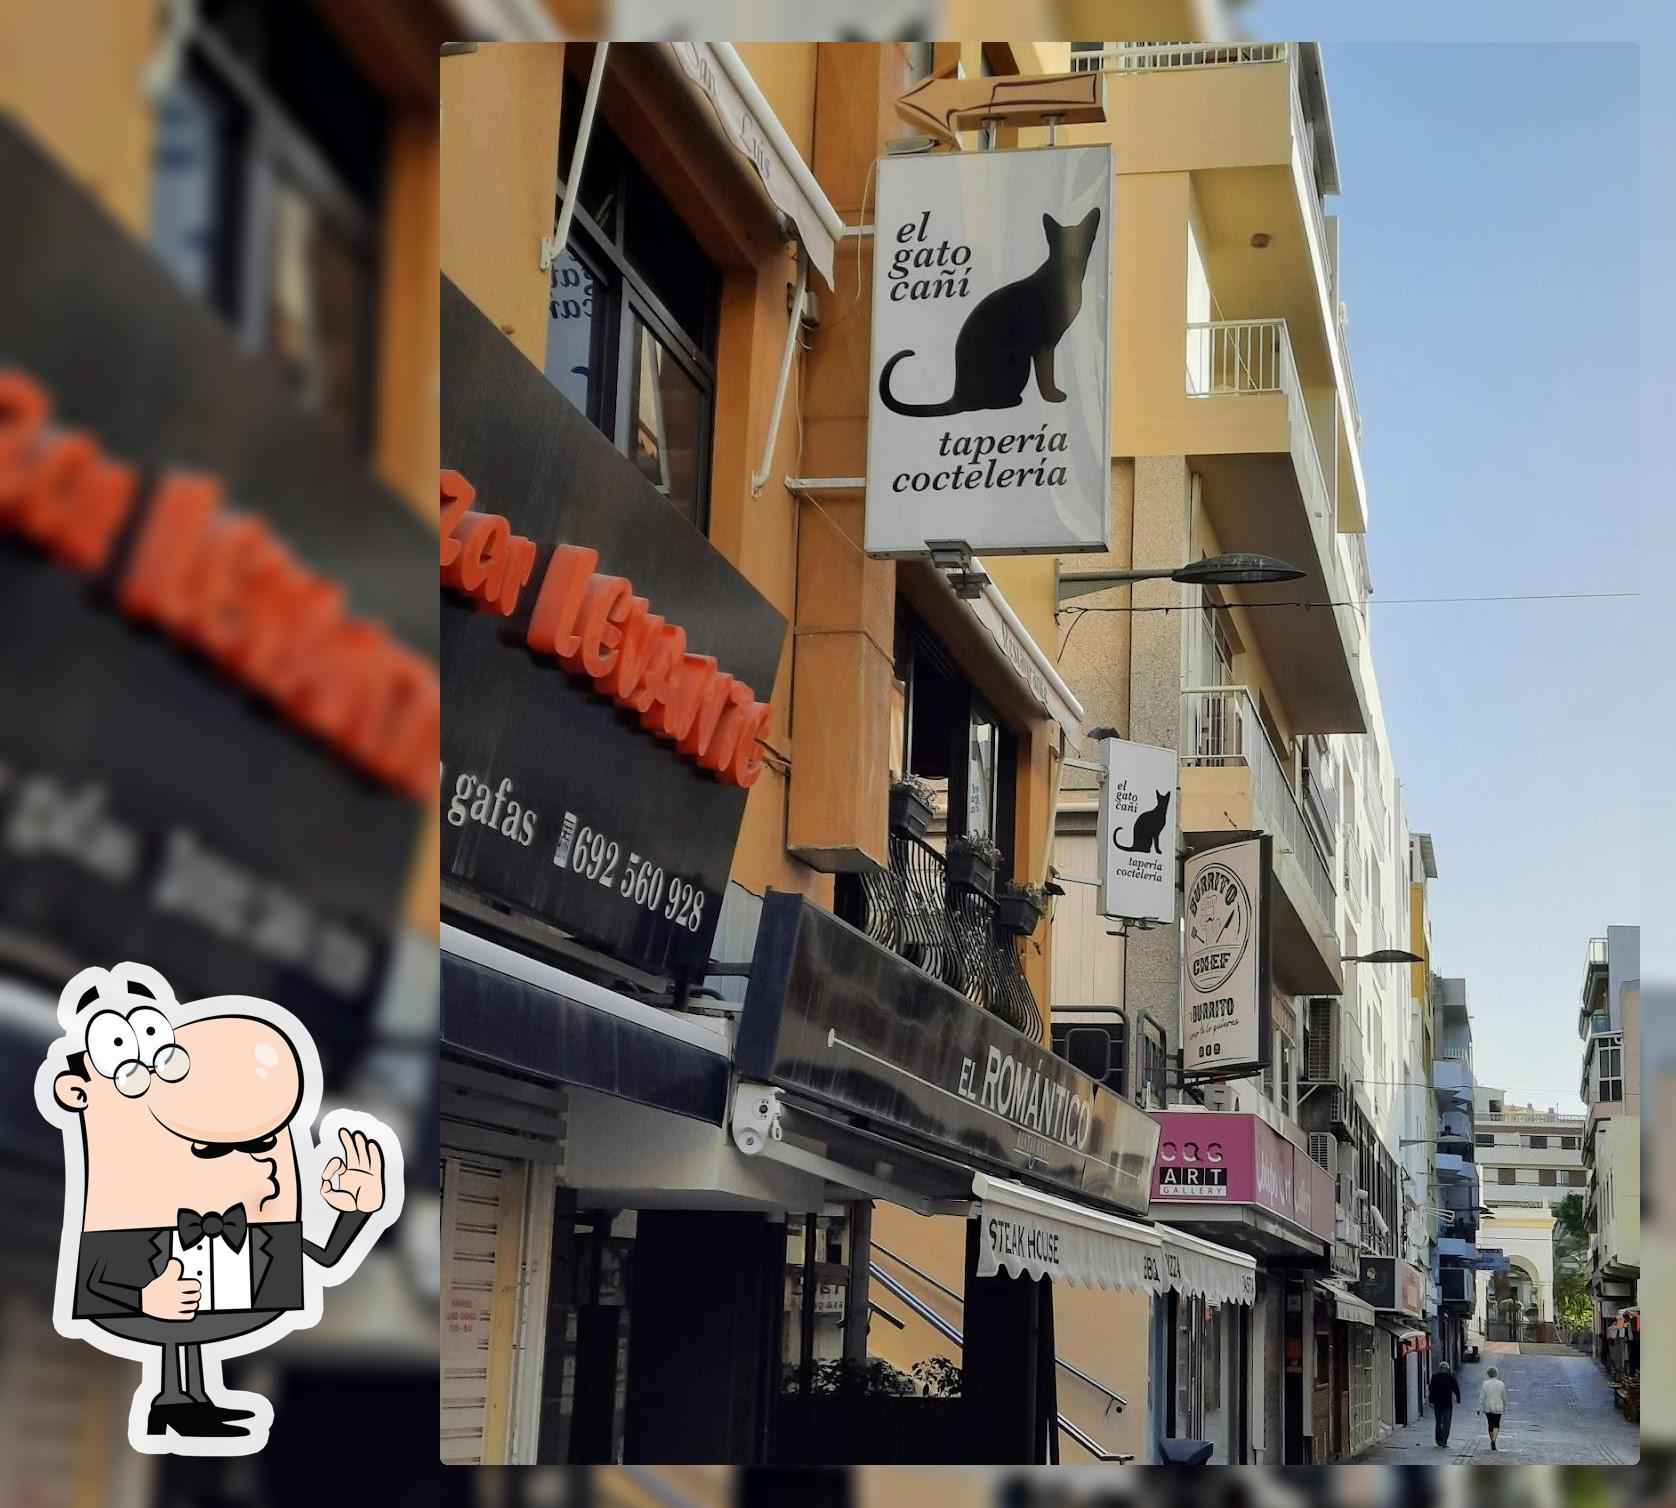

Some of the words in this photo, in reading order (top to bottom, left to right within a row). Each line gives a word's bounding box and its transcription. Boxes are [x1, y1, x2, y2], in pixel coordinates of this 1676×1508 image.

[895, 210, 931, 244] el
[888, 241, 972, 280] gato
[889, 267, 974, 302] cañí
[938, 424, 1068, 465] tapería
[892, 457, 1068, 493] coctelería
[1115, 791, 1138, 803] gato
[1117, 780, 1128, 791] el
[447, 773, 539, 847] gafas
[572, 826, 619, 888] 692
[620, 852, 664, 911] 560
[664, 877, 705, 933] 928
[1128, 857, 1163, 871] tapería
[1116, 868, 1163, 882] coctelería
[1189, 872, 1238, 918] BURRITO
[1193, 952, 1231, 976] CHEF
[1192, 997, 1235, 1023] BURRITO
[958, 1056, 977, 1101] EL
[980, 1044, 1094, 1151] ROMÁNTICO
[1163, 1186, 1223, 1195] GALLERY
[1164, 1168, 1223, 1185] ART
[989, 1218, 1025, 1258] STEAK
[1028, 1230, 1060, 1264] HOUSE
